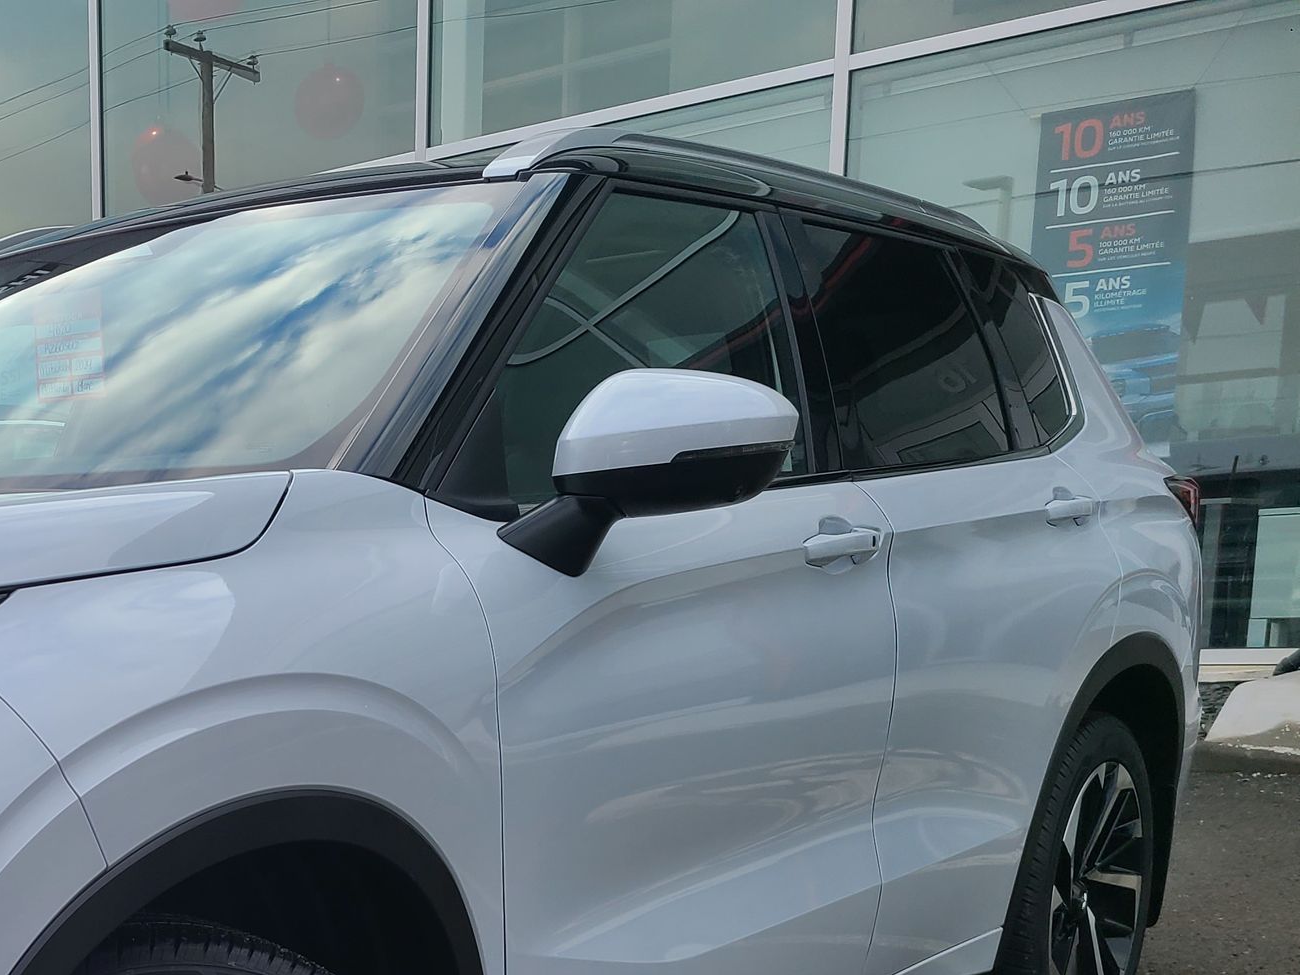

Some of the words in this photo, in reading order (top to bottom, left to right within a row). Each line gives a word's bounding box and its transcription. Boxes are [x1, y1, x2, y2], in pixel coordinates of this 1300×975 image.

[1055, 118, 1104, 161] 10
[1109, 111, 1146, 129] ANS
[1108, 135, 1145, 146] GARANTIE
[1146, 128, 1174, 140] LIMITÉE
[1109, 130, 1121, 138] 160
[1122, 128, 1137, 136] 000
[1050, 175, 1099, 217] 10
[1104, 168, 1141, 186] ANS
[1103, 193, 1140, 203] GARANTIE
[1141, 187, 1169, 198] LIMITÉE
[1104, 187, 1117, 195] 160
[1118, 185, 1133, 193] 000
[1066, 228, 1094, 269] 5
[1101, 223, 1136, 240] ANS
[1098, 245, 1135, 255] GARANTIE
[1136, 240, 1165, 251] LIMITÉE
[1064, 280, 1090, 318] 5
[1095, 275, 1131, 292] ANS
[1094, 288, 1147, 301] KILOMÉTRAGE
